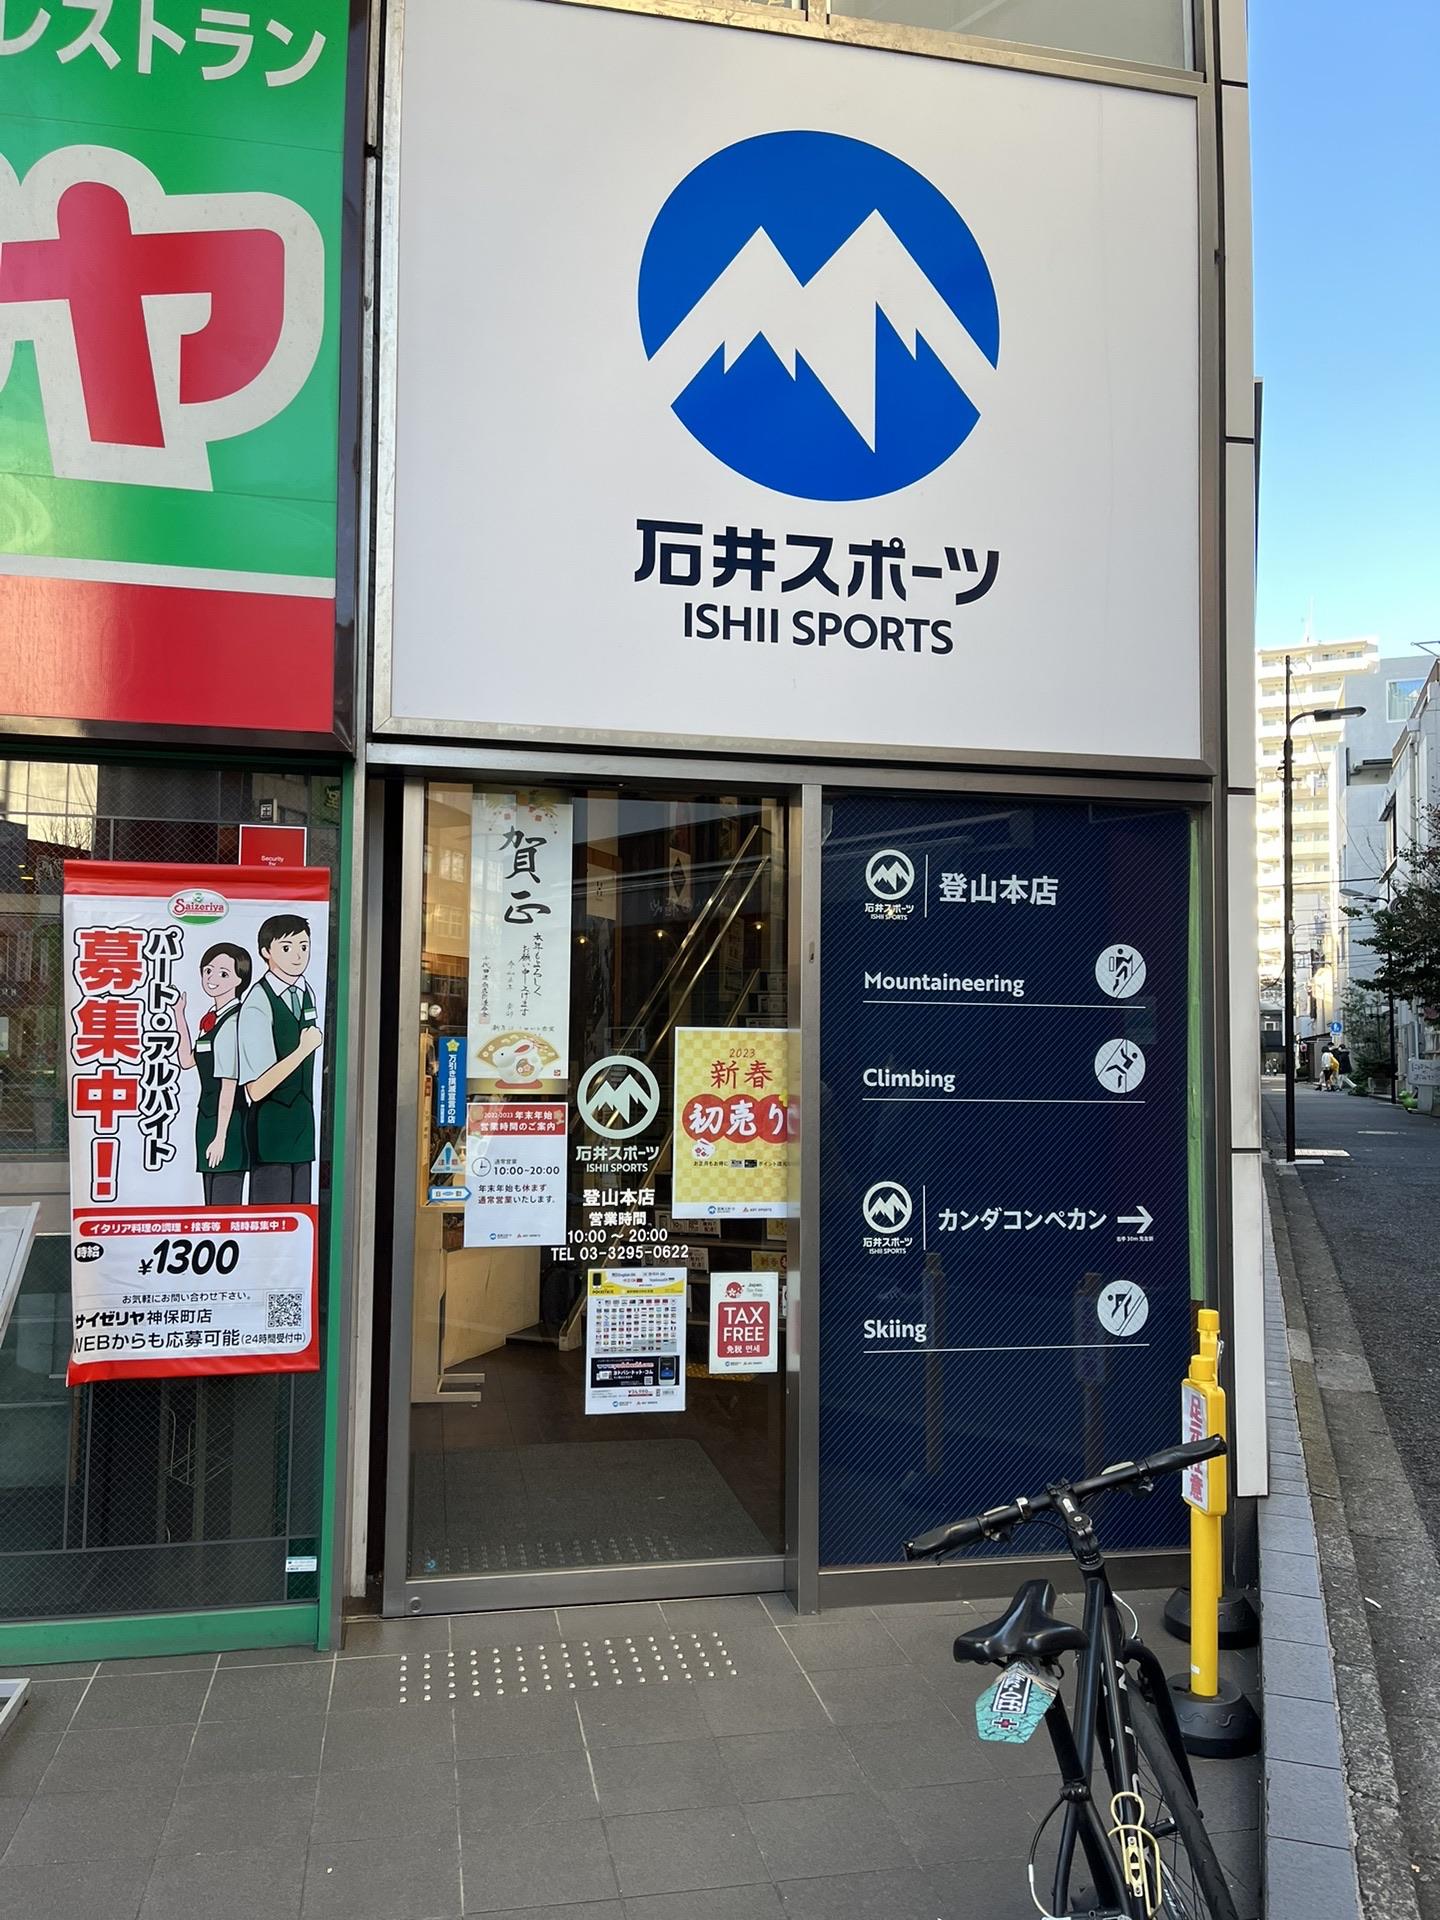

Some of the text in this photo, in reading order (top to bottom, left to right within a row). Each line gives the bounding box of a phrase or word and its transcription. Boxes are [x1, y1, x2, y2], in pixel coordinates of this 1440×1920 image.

[634, 518, 1000, 606] 石井スポーツ
[684, 602, 954, 655] ISHII SPORTS
[261, 855, 285, 863] Security
[499, 825, 551, 925] 賀正
[939, 872, 1059, 906] 登山本店
[174, 898, 225, 912] Saizeriya
[864, 903, 915, 914] 石井スポーツ
[864, 971, 1025, 998] Mountaineering
[145, 930, 182, 1168] パート・アルバイト
[729, 1048, 756, 1058] 2023
[710, 1060, 773, 1089] 新春
[863, 1068, 956, 1093] Climbing
[515, 1111, 553, 1120] 年末年始
[689, 1099, 784, 1137] 初売り
[480, 1122, 556, 1131] 営業時間のご案内
[575, 1145, 660, 1161] 石井スポーツ
[586, 1163, 648, 1172] ISHII SPORTS
[478, 1184, 548, 1193] 年末年始も休まず
[582, 1188, 656, 1207] 登山本店
[588, 1211, 648, 1227] 営業時間
[938, 1207, 1107, 1231] カンダコンペカン
[863, 1237, 913, 1248] 石井スポーツ
[76, 1245, 101, 1260] 時給
[551, 1245, 689, 1261] TEL 03-3295-0622
[122, 1292, 253, 1304] お気軽にお問い合わせ下さい。
[723, 1306, 764, 1325] TAX
[723, 1326, 765, 1342] FREE
[863, 1319, 927, 1342] Skiing
